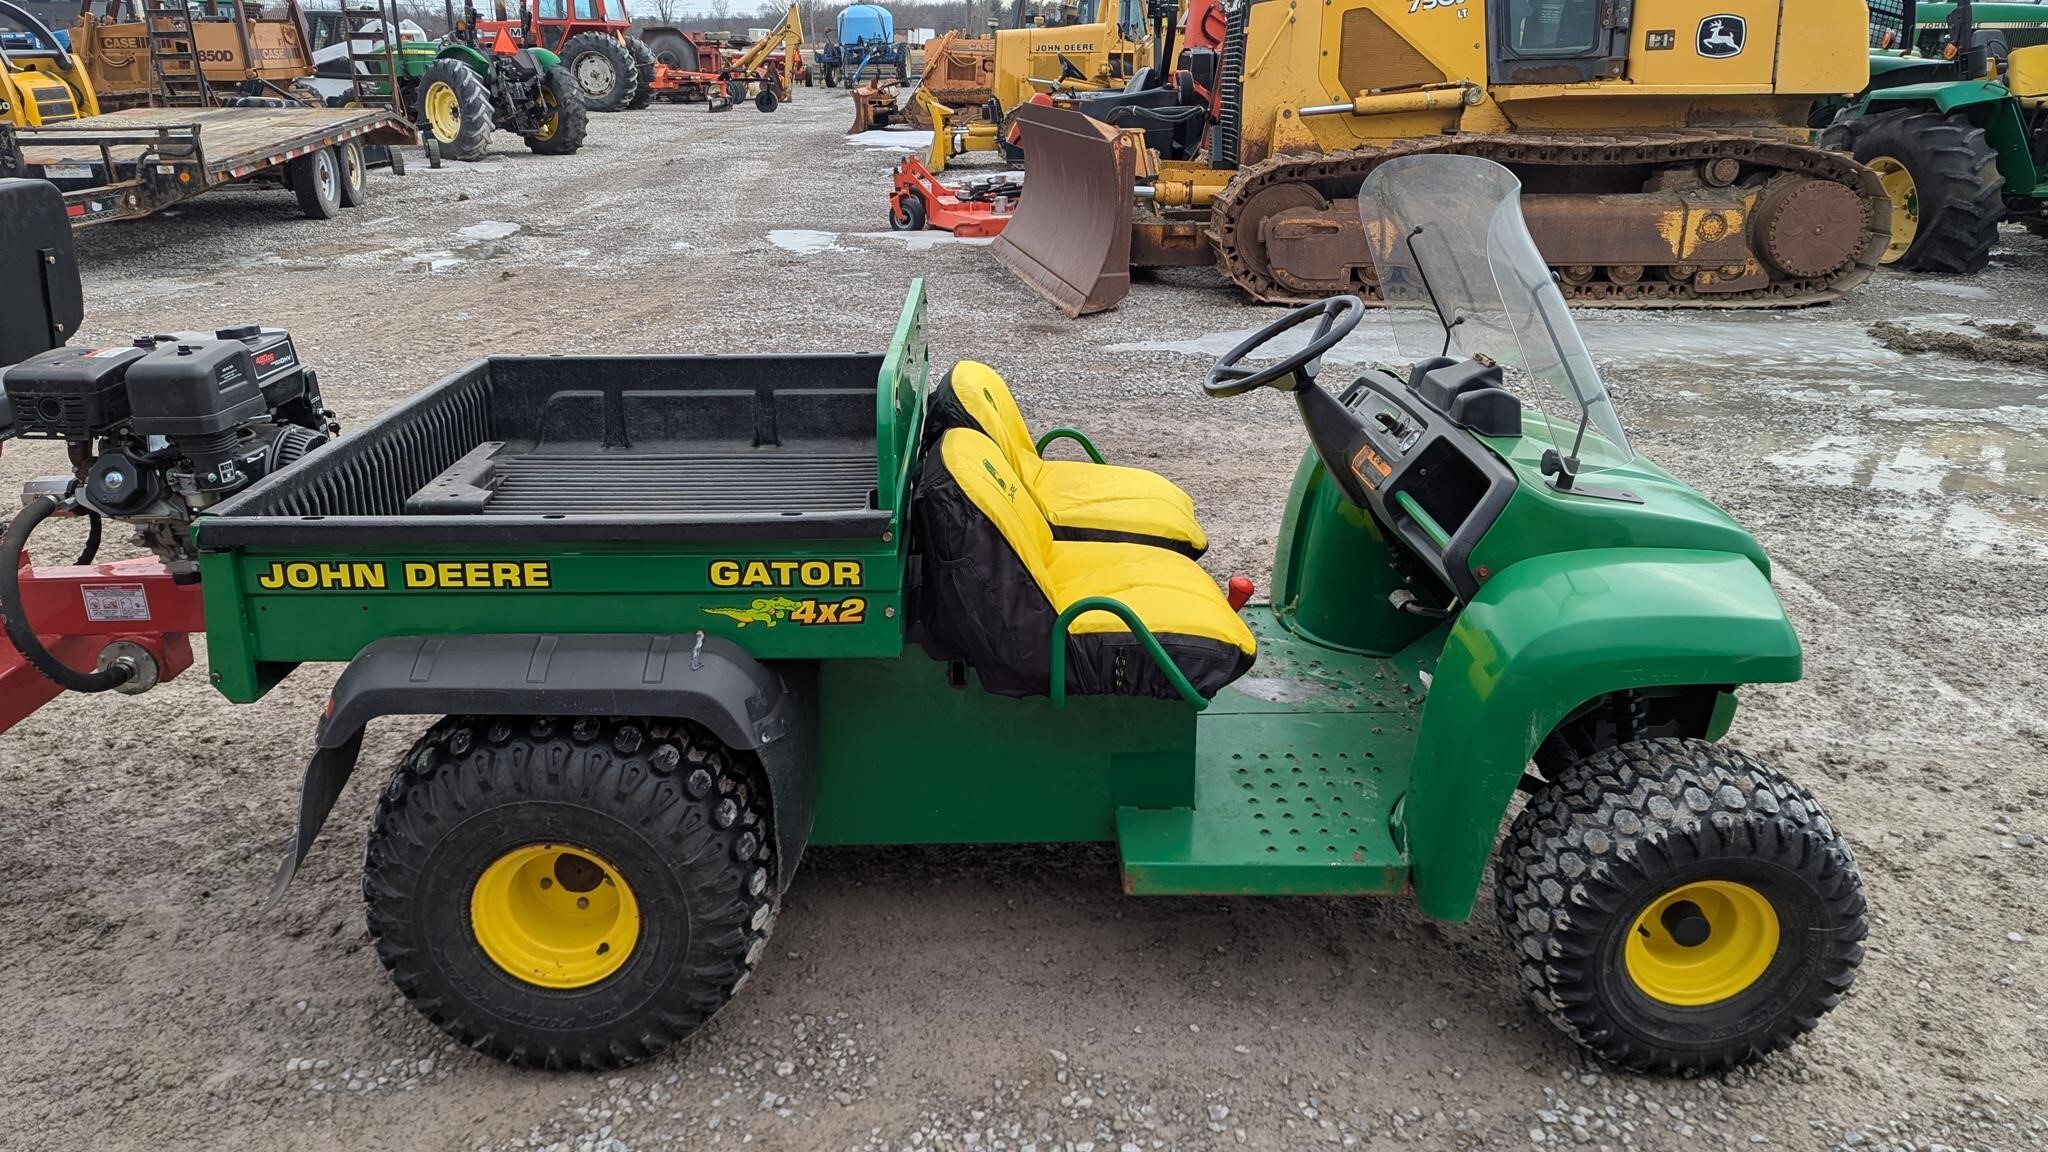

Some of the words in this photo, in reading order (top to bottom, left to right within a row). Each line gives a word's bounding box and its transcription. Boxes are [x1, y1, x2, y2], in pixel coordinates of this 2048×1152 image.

[1457, 8, 1468, 19] LT
[104, 37, 138, 49] CASE
[968, 42, 995, 51] CASE
[1035, 44, 1060, 52] JOHN
[1064, 43, 1094, 51] DEERE
[262, 49, 285, 60] CASE
[258, 562, 387, 589] JOHN
[403, 561, 551, 588] DEERE
[709, 560, 863, 588] GATOR
[790, 598, 866, 625] 4x2
